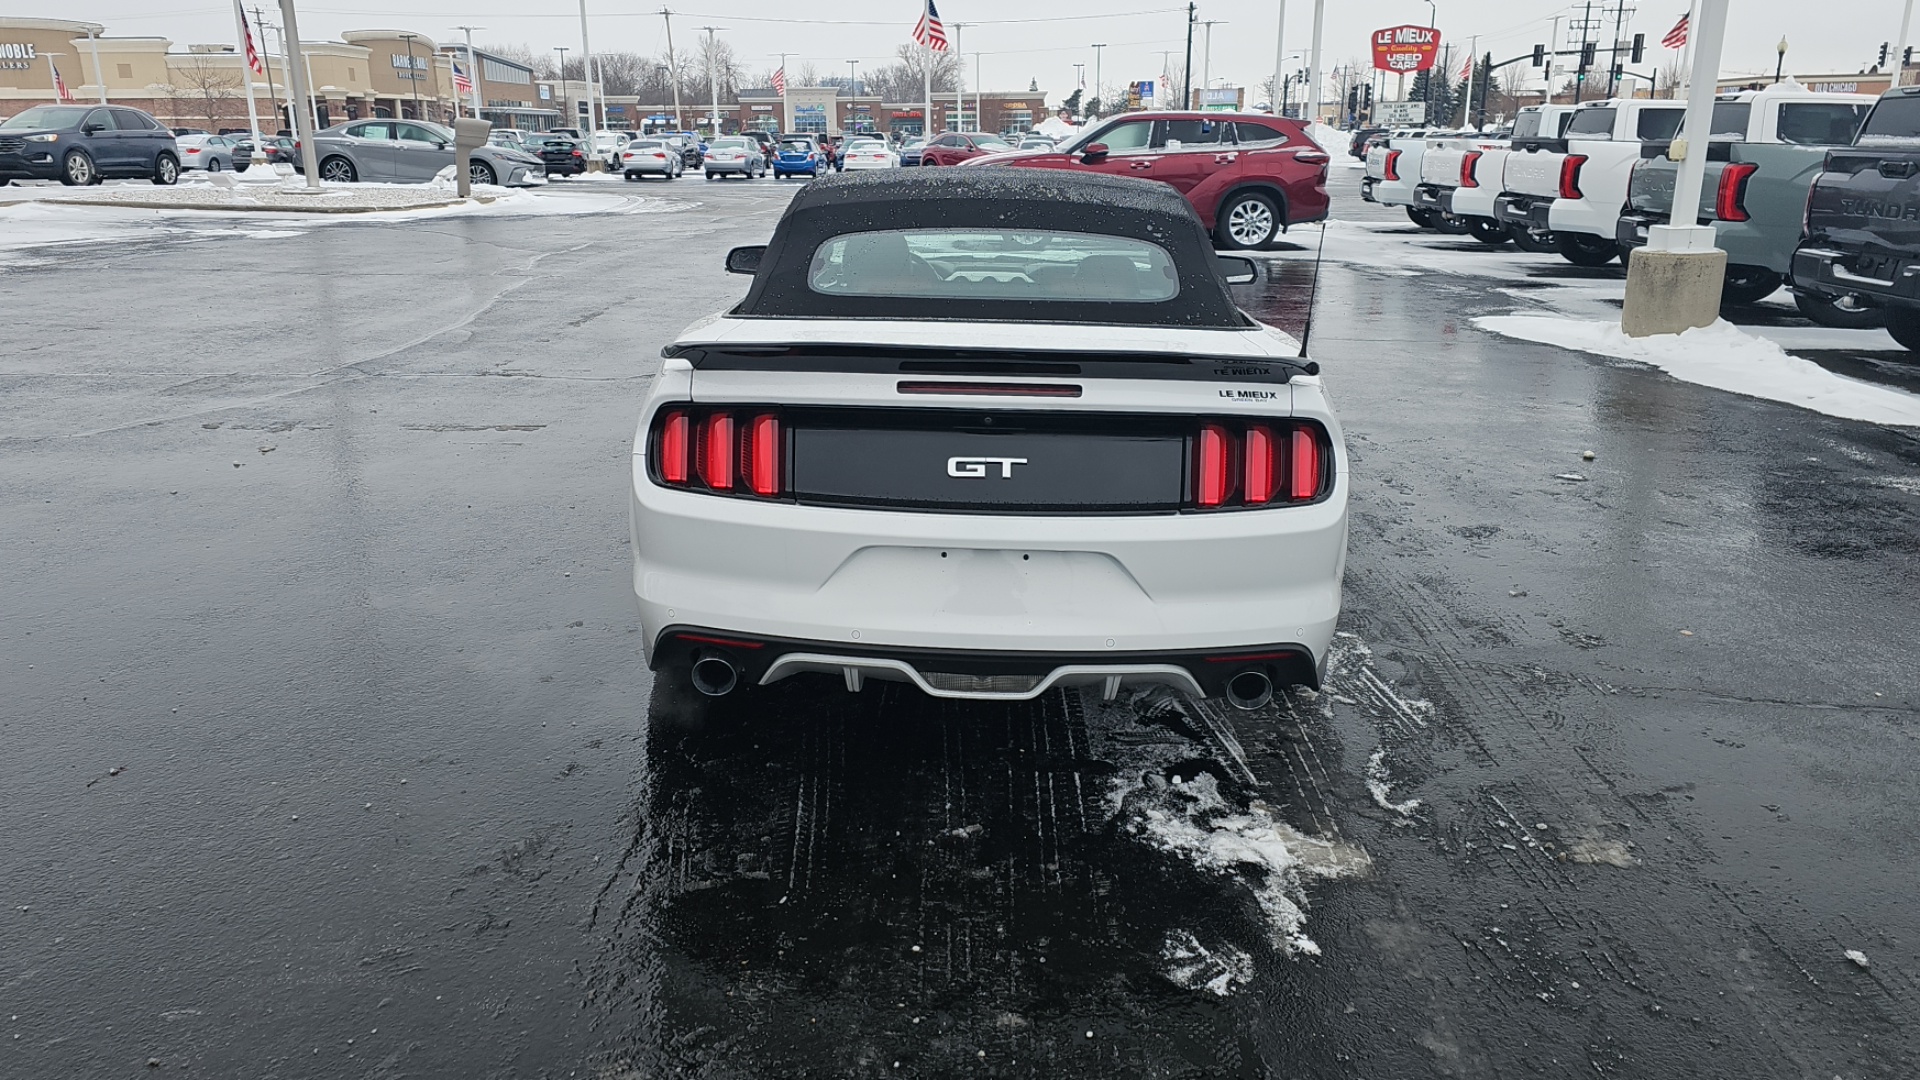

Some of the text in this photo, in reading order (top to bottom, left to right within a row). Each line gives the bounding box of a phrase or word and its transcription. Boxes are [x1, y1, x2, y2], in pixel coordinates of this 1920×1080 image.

[1377, 27, 1434, 44] LE MIEUX
[1391, 44, 1418, 53] Quality
[1387, 53, 1422, 62] USED
[1390, 61, 1418, 70] CARS
[1829, 81, 1858, 93] CHICAGO
[1219, 390, 1278, 399] LE MIEUX
[947, 456, 1028, 478] GT
